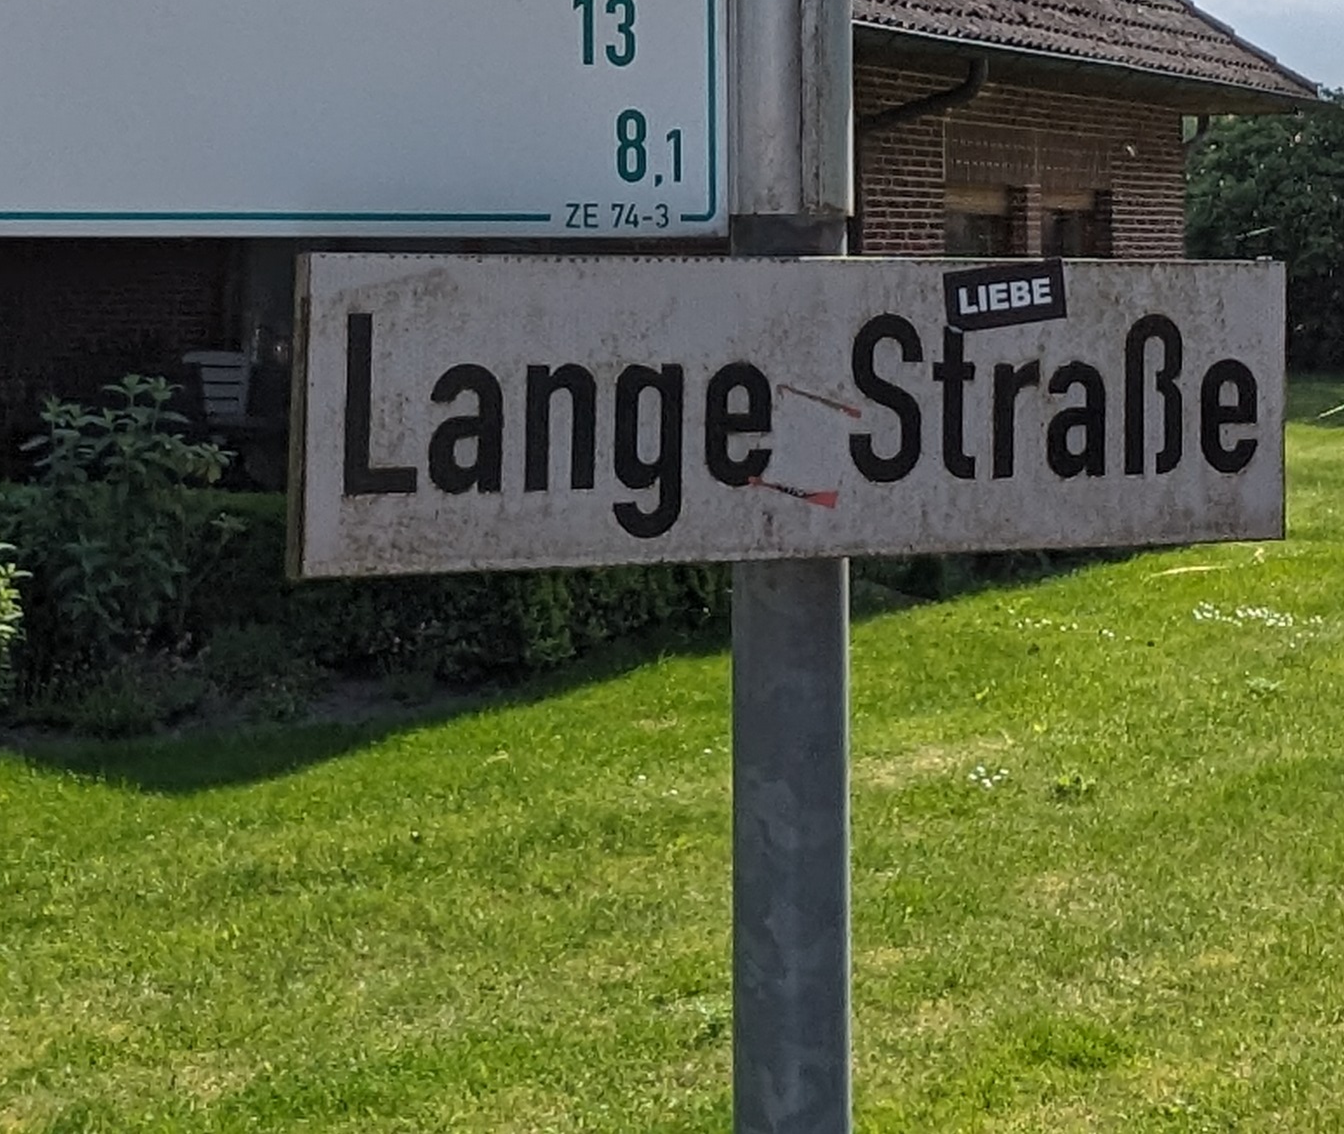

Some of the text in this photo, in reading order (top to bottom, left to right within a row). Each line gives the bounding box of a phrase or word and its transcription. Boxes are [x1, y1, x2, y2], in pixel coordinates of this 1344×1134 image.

[616, 108, 681, 187] 8,1
[565, 203, 670, 229] ZE 74-3
[958, 277, 1053, 315] LIEBE
[343, 312, 1259, 539] Lange Straße
